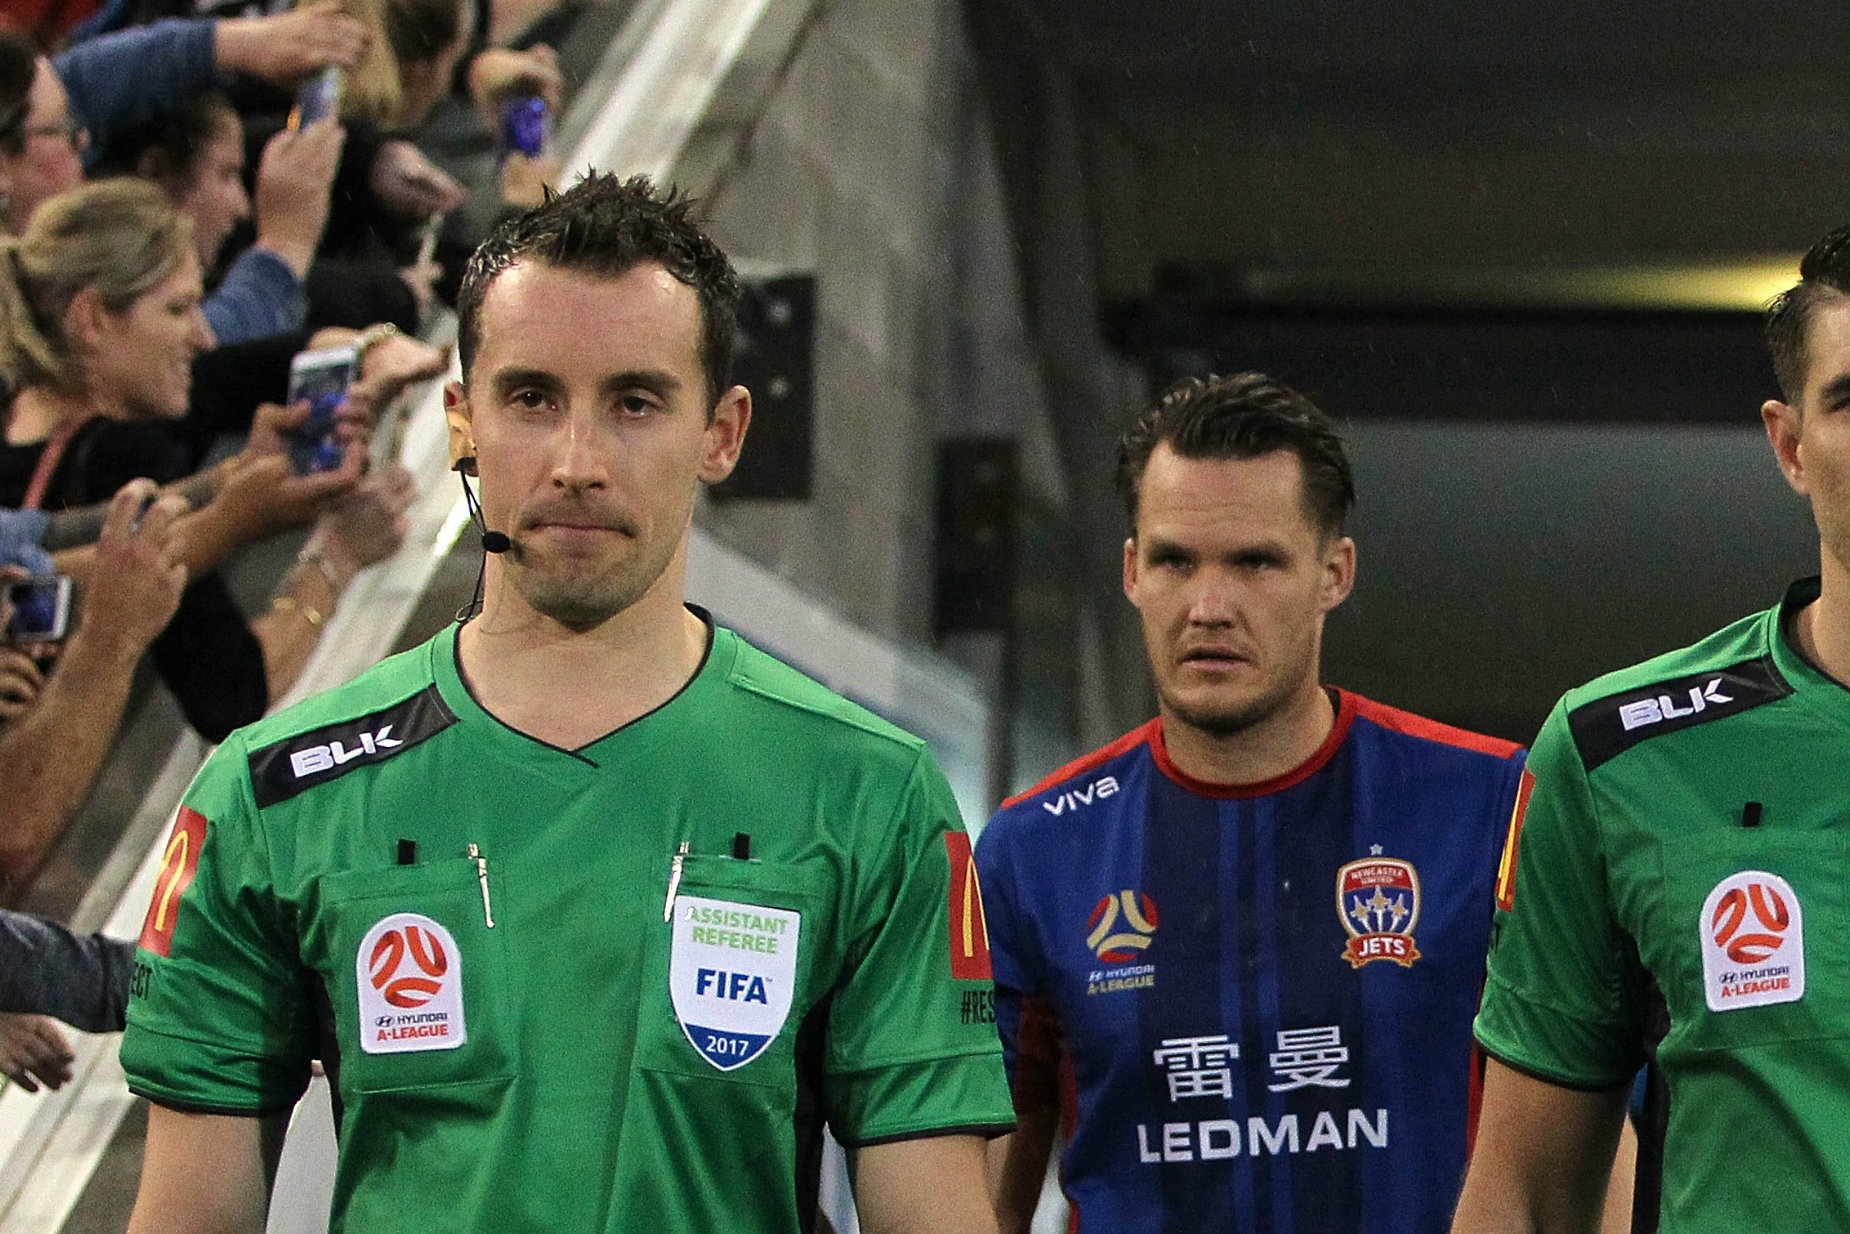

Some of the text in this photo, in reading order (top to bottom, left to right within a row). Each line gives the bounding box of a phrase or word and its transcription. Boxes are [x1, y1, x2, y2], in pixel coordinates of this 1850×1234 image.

[1619, 678, 1734, 731] BLK
[289, 724, 403, 778] BLK
[685, 906, 788, 935] ASSISTANT
[692, 925, 778, 954] REFEREE
[1359, 938, 1406, 957] JETS
[1740, 966, 1789, 980] HYUNDAI
[397, 1012, 448, 1025] HYUNDAI
[706, 1035, 750, 1057] 2017
[1153, 1025, 1350, 1102] 雷曼
[1137, 1109, 1388, 1163] LEDMAN
